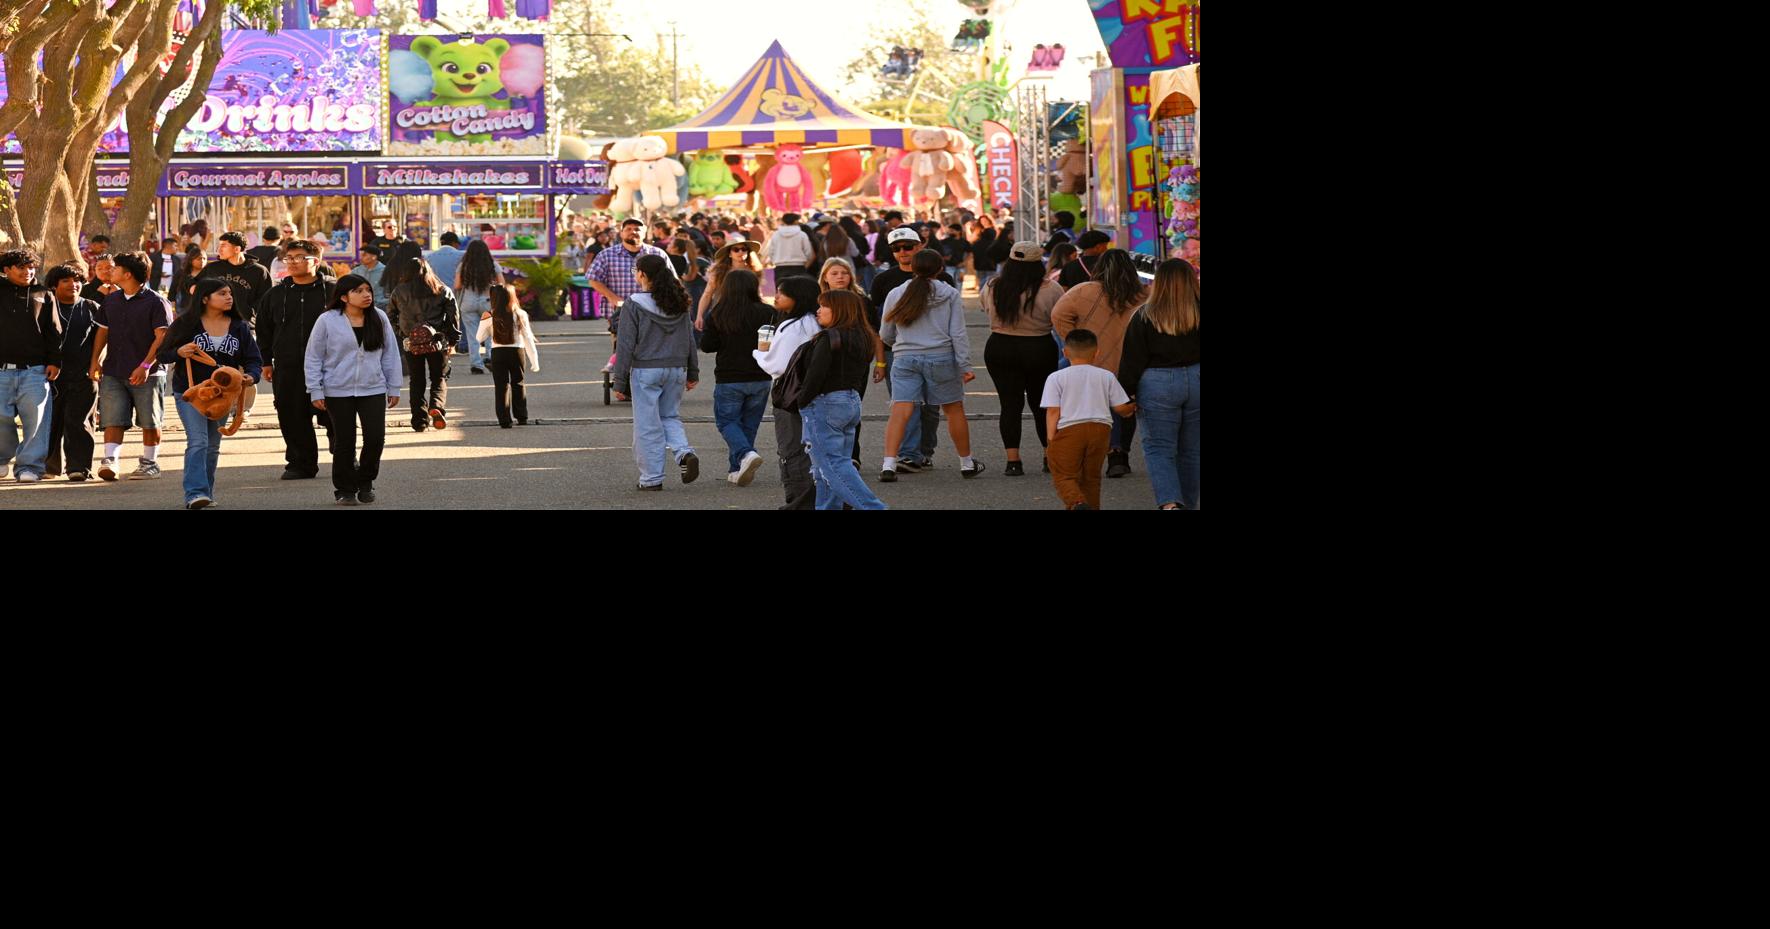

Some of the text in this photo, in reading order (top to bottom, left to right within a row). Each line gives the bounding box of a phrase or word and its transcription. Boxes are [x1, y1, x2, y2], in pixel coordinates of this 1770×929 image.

[186, 95, 375, 133] Drinks
[396, 104, 488, 128] Cotton
[451, 111, 535, 136] Candy
[174, 169, 341, 188] Gourmet Apples
[377, 169, 530, 185] Milkshakes
[556, 168, 584, 183] Hot
[990, 131, 1012, 206] CHECK
